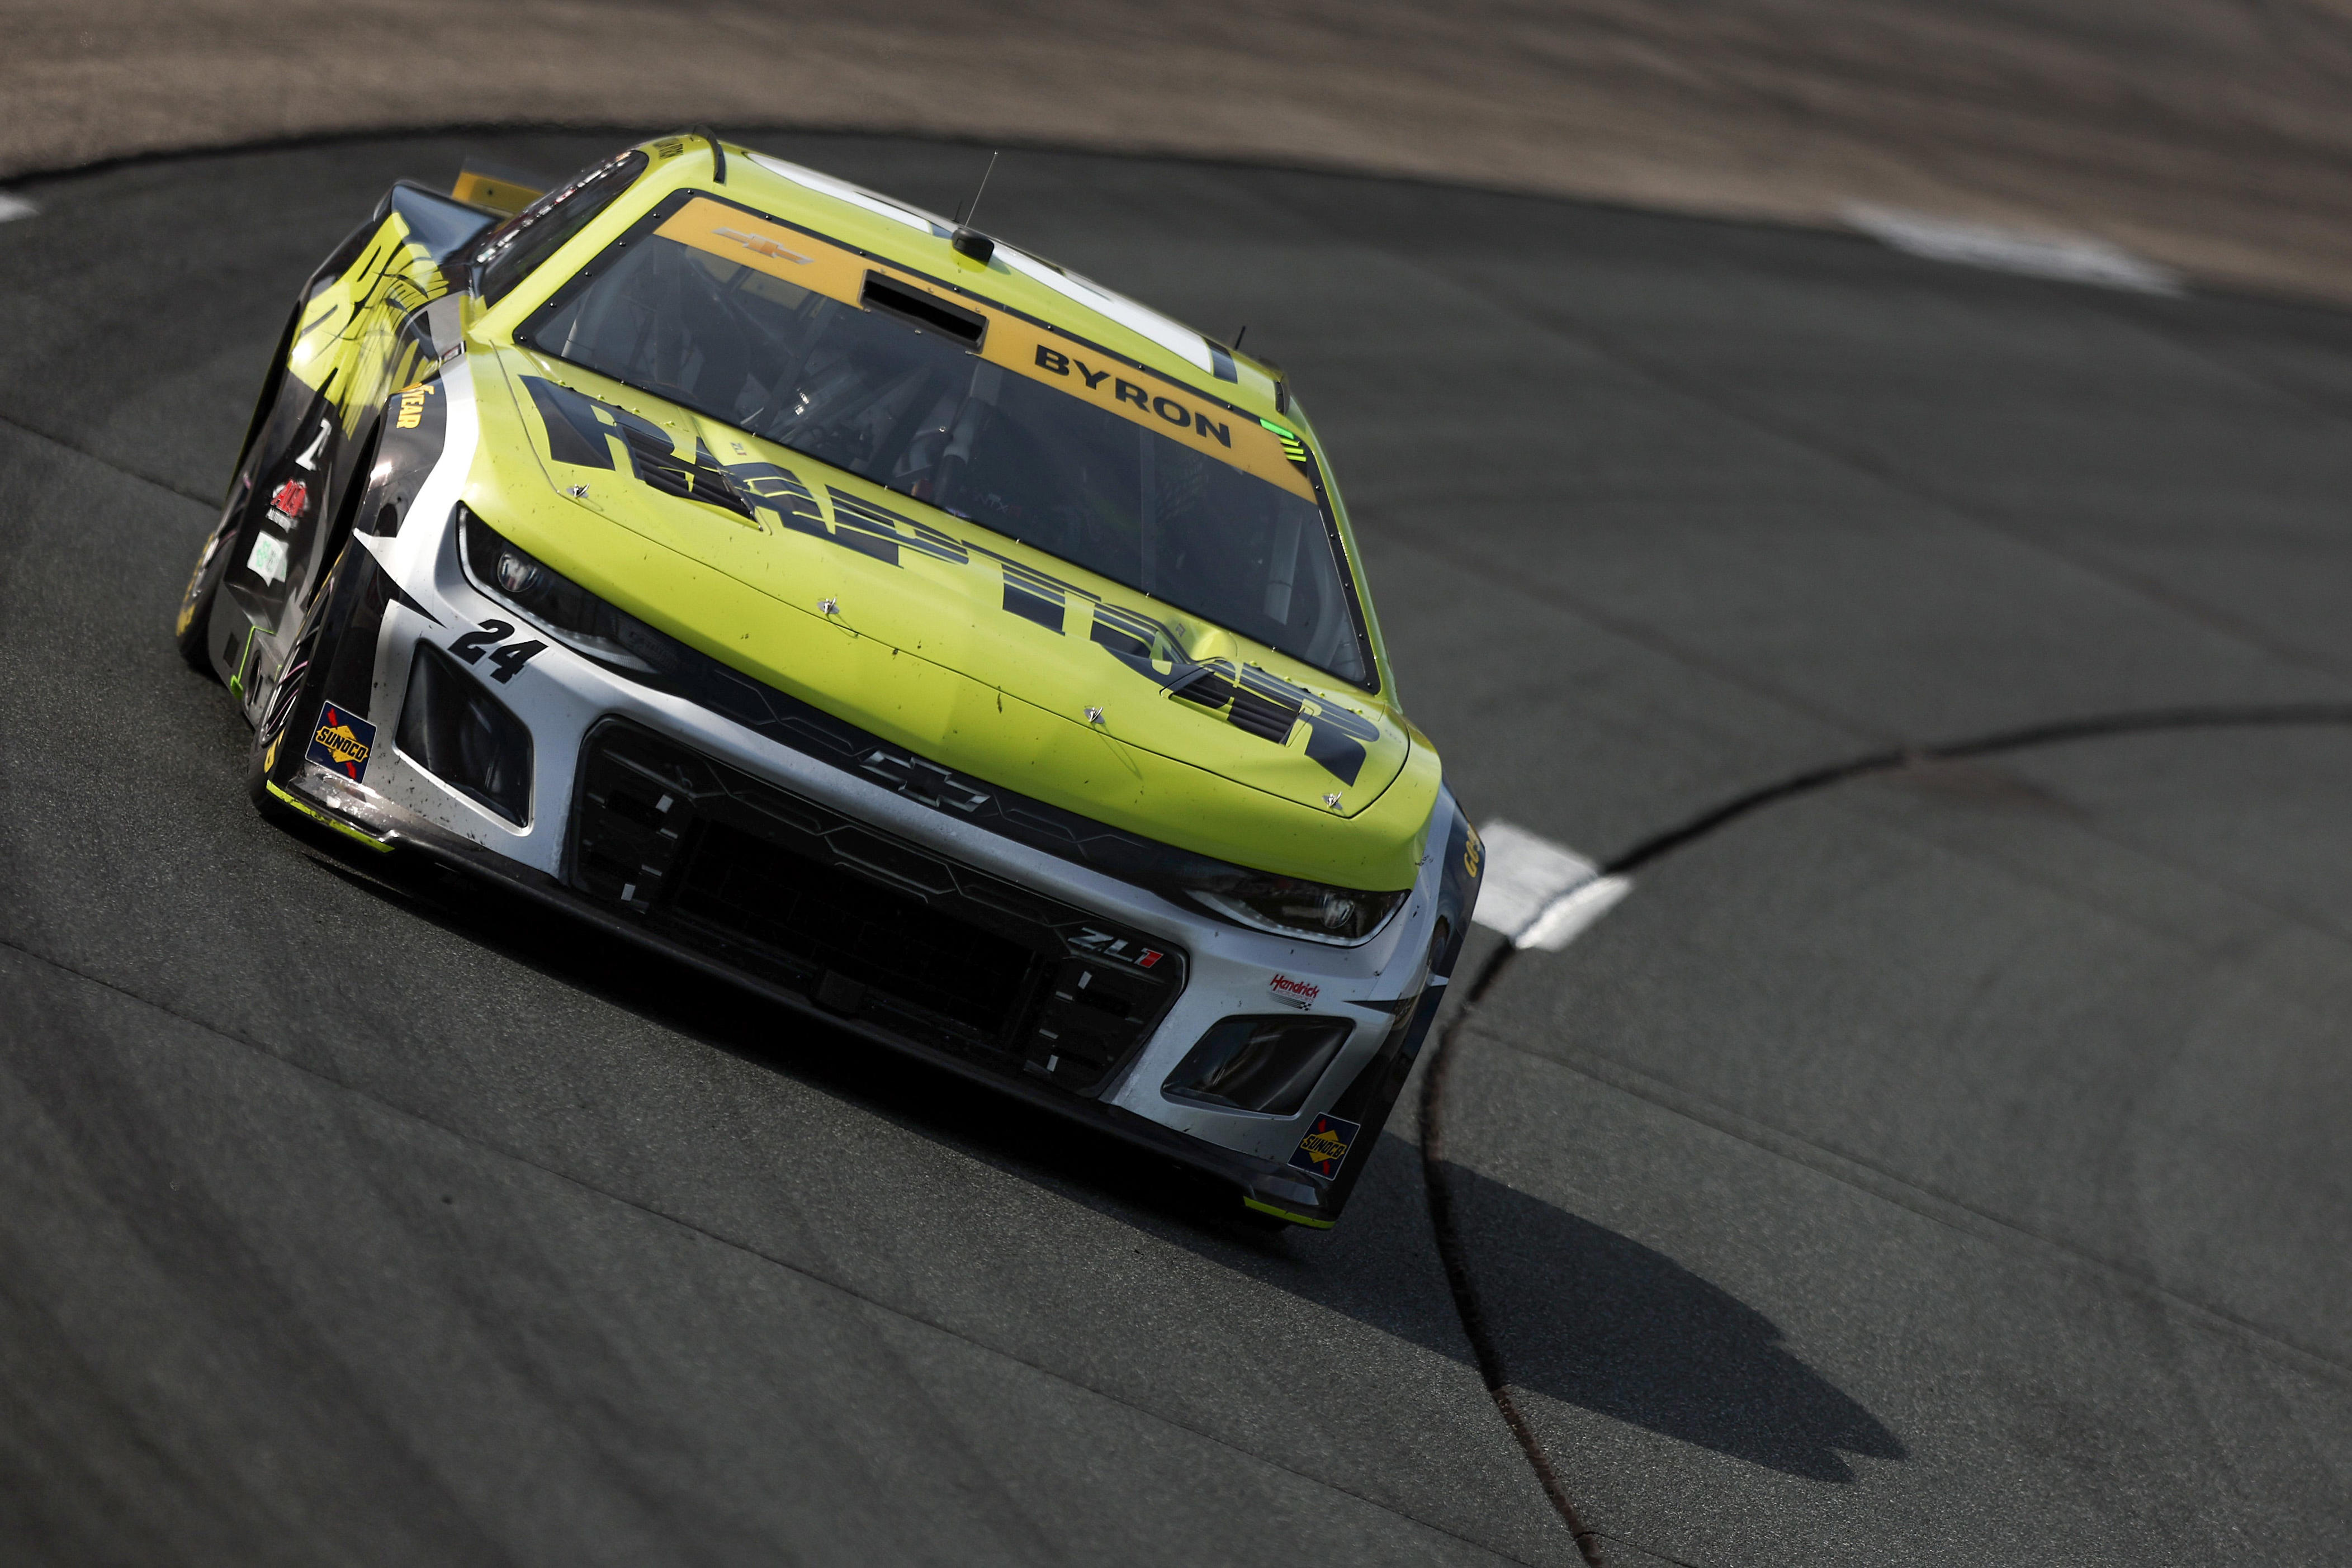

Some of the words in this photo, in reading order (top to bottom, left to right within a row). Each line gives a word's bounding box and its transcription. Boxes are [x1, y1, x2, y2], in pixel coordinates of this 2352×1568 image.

[1035, 344, 1232, 449] BYRON
[447, 619, 549, 685] 24
[317, 728, 367, 761] SUNOCO
[1067, 927, 1165, 969] ZL1
[1270, 974, 1320, 998] Hendrick
[1302, 1135, 1345, 1159] SUNOCO
